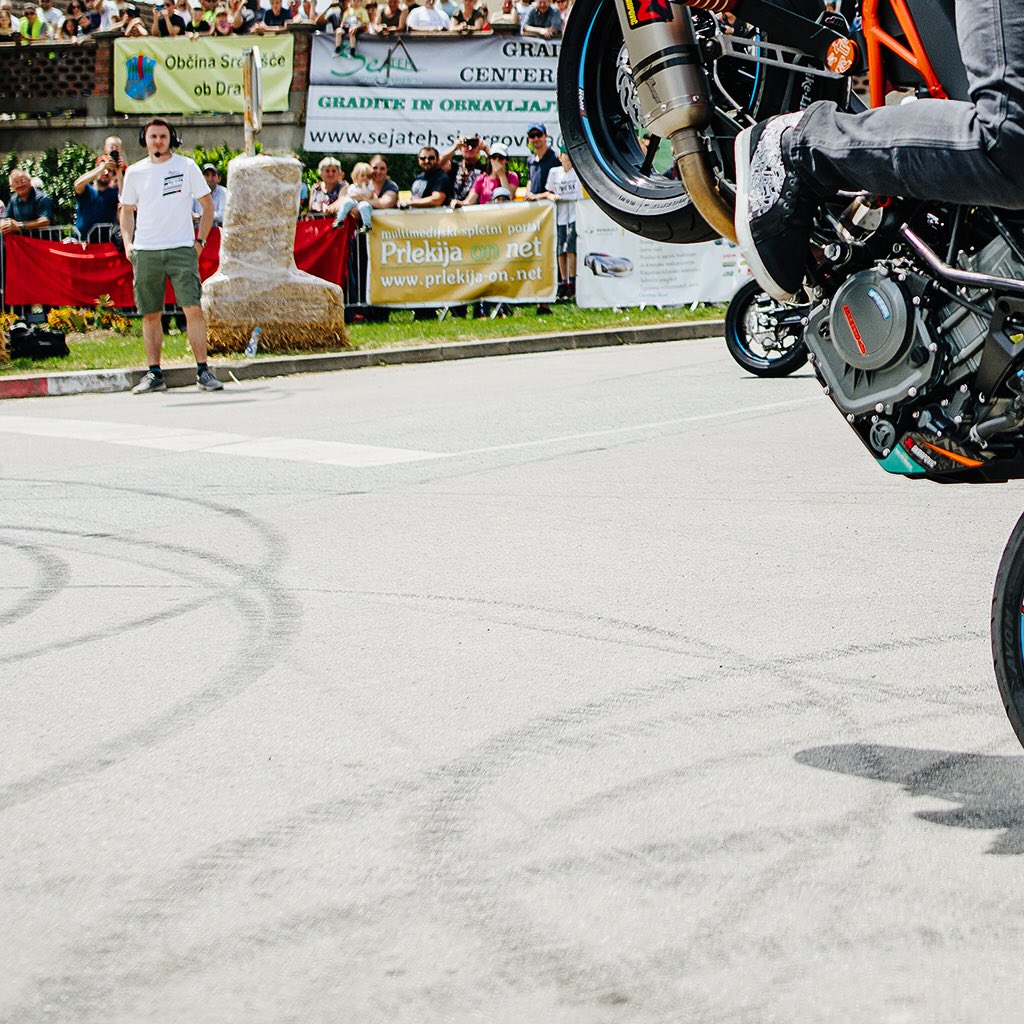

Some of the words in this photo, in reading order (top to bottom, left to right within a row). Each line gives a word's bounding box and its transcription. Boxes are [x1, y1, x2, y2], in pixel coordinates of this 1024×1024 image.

[165, 53, 216, 70] Občina
[220, 52, 286, 69] Srešče
[459, 67, 555, 83] CENTER
[194, 82, 212, 97] ob
[216, 80, 246, 96] Dra
[317, 95, 406, 110] GRADITE
[411, 98, 434, 111] IN
[381, 239, 463, 268] Prlekija
[471, 243, 499, 261] on
[505, 236, 542, 259] net
